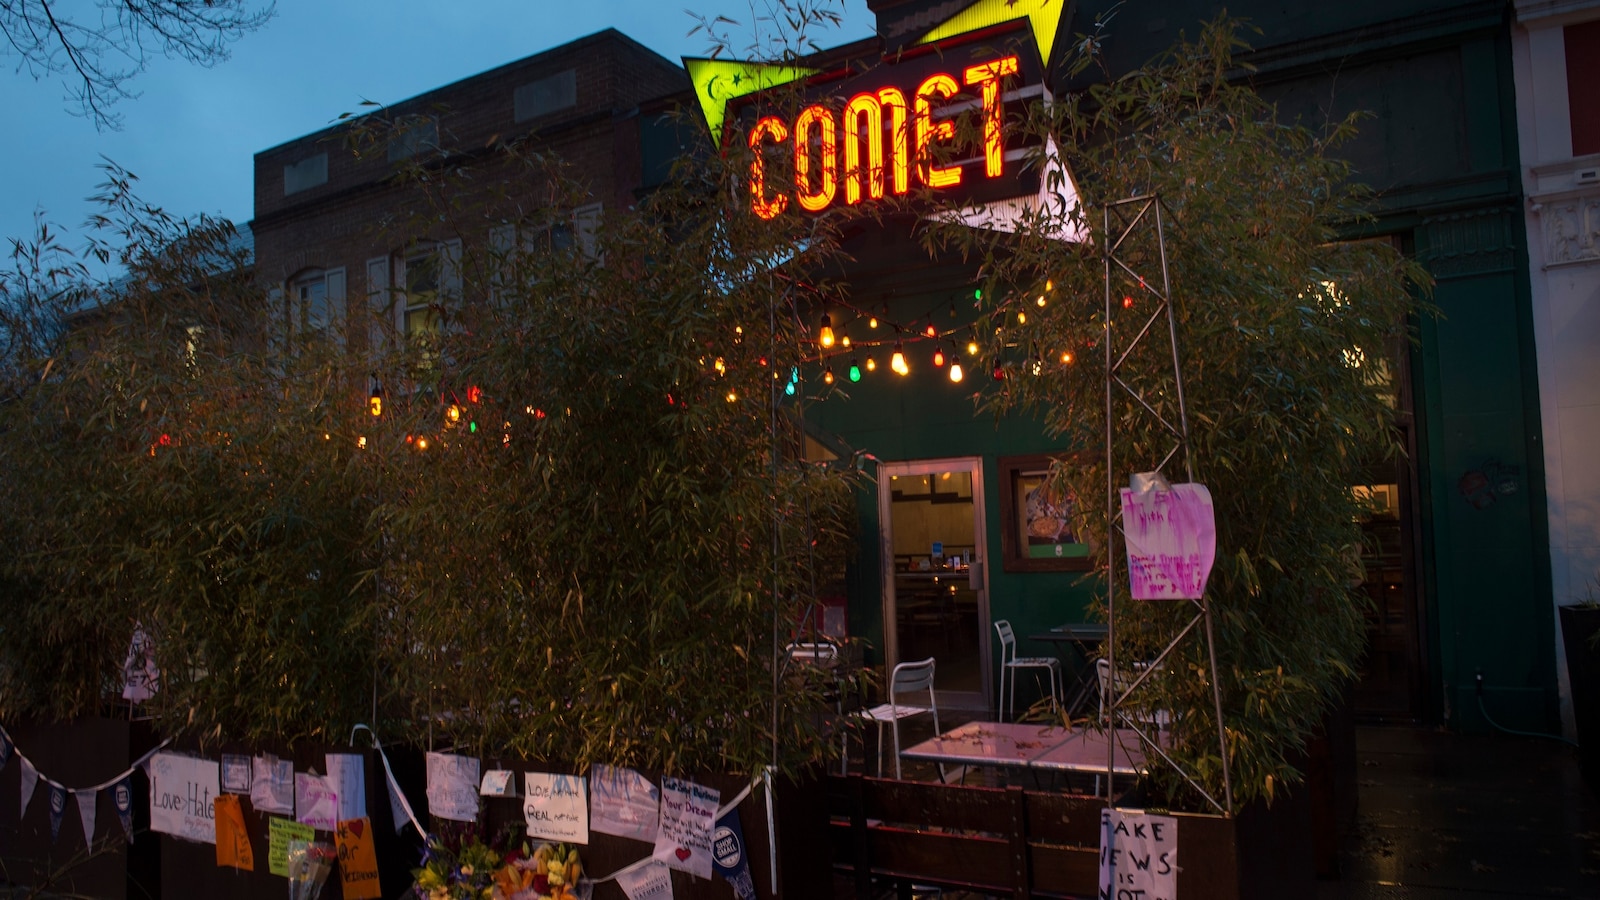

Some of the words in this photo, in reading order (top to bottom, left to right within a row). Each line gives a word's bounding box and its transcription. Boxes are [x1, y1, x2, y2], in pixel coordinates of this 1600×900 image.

[748, 54, 1020, 220] COMET
[664, 794, 683, 811] Your
[685, 801, 713, 819] Dream
[715, 836, 733, 849] SHOP
[717, 843, 738, 858] SMALL
[634, 880, 669, 900] SATURDAY
